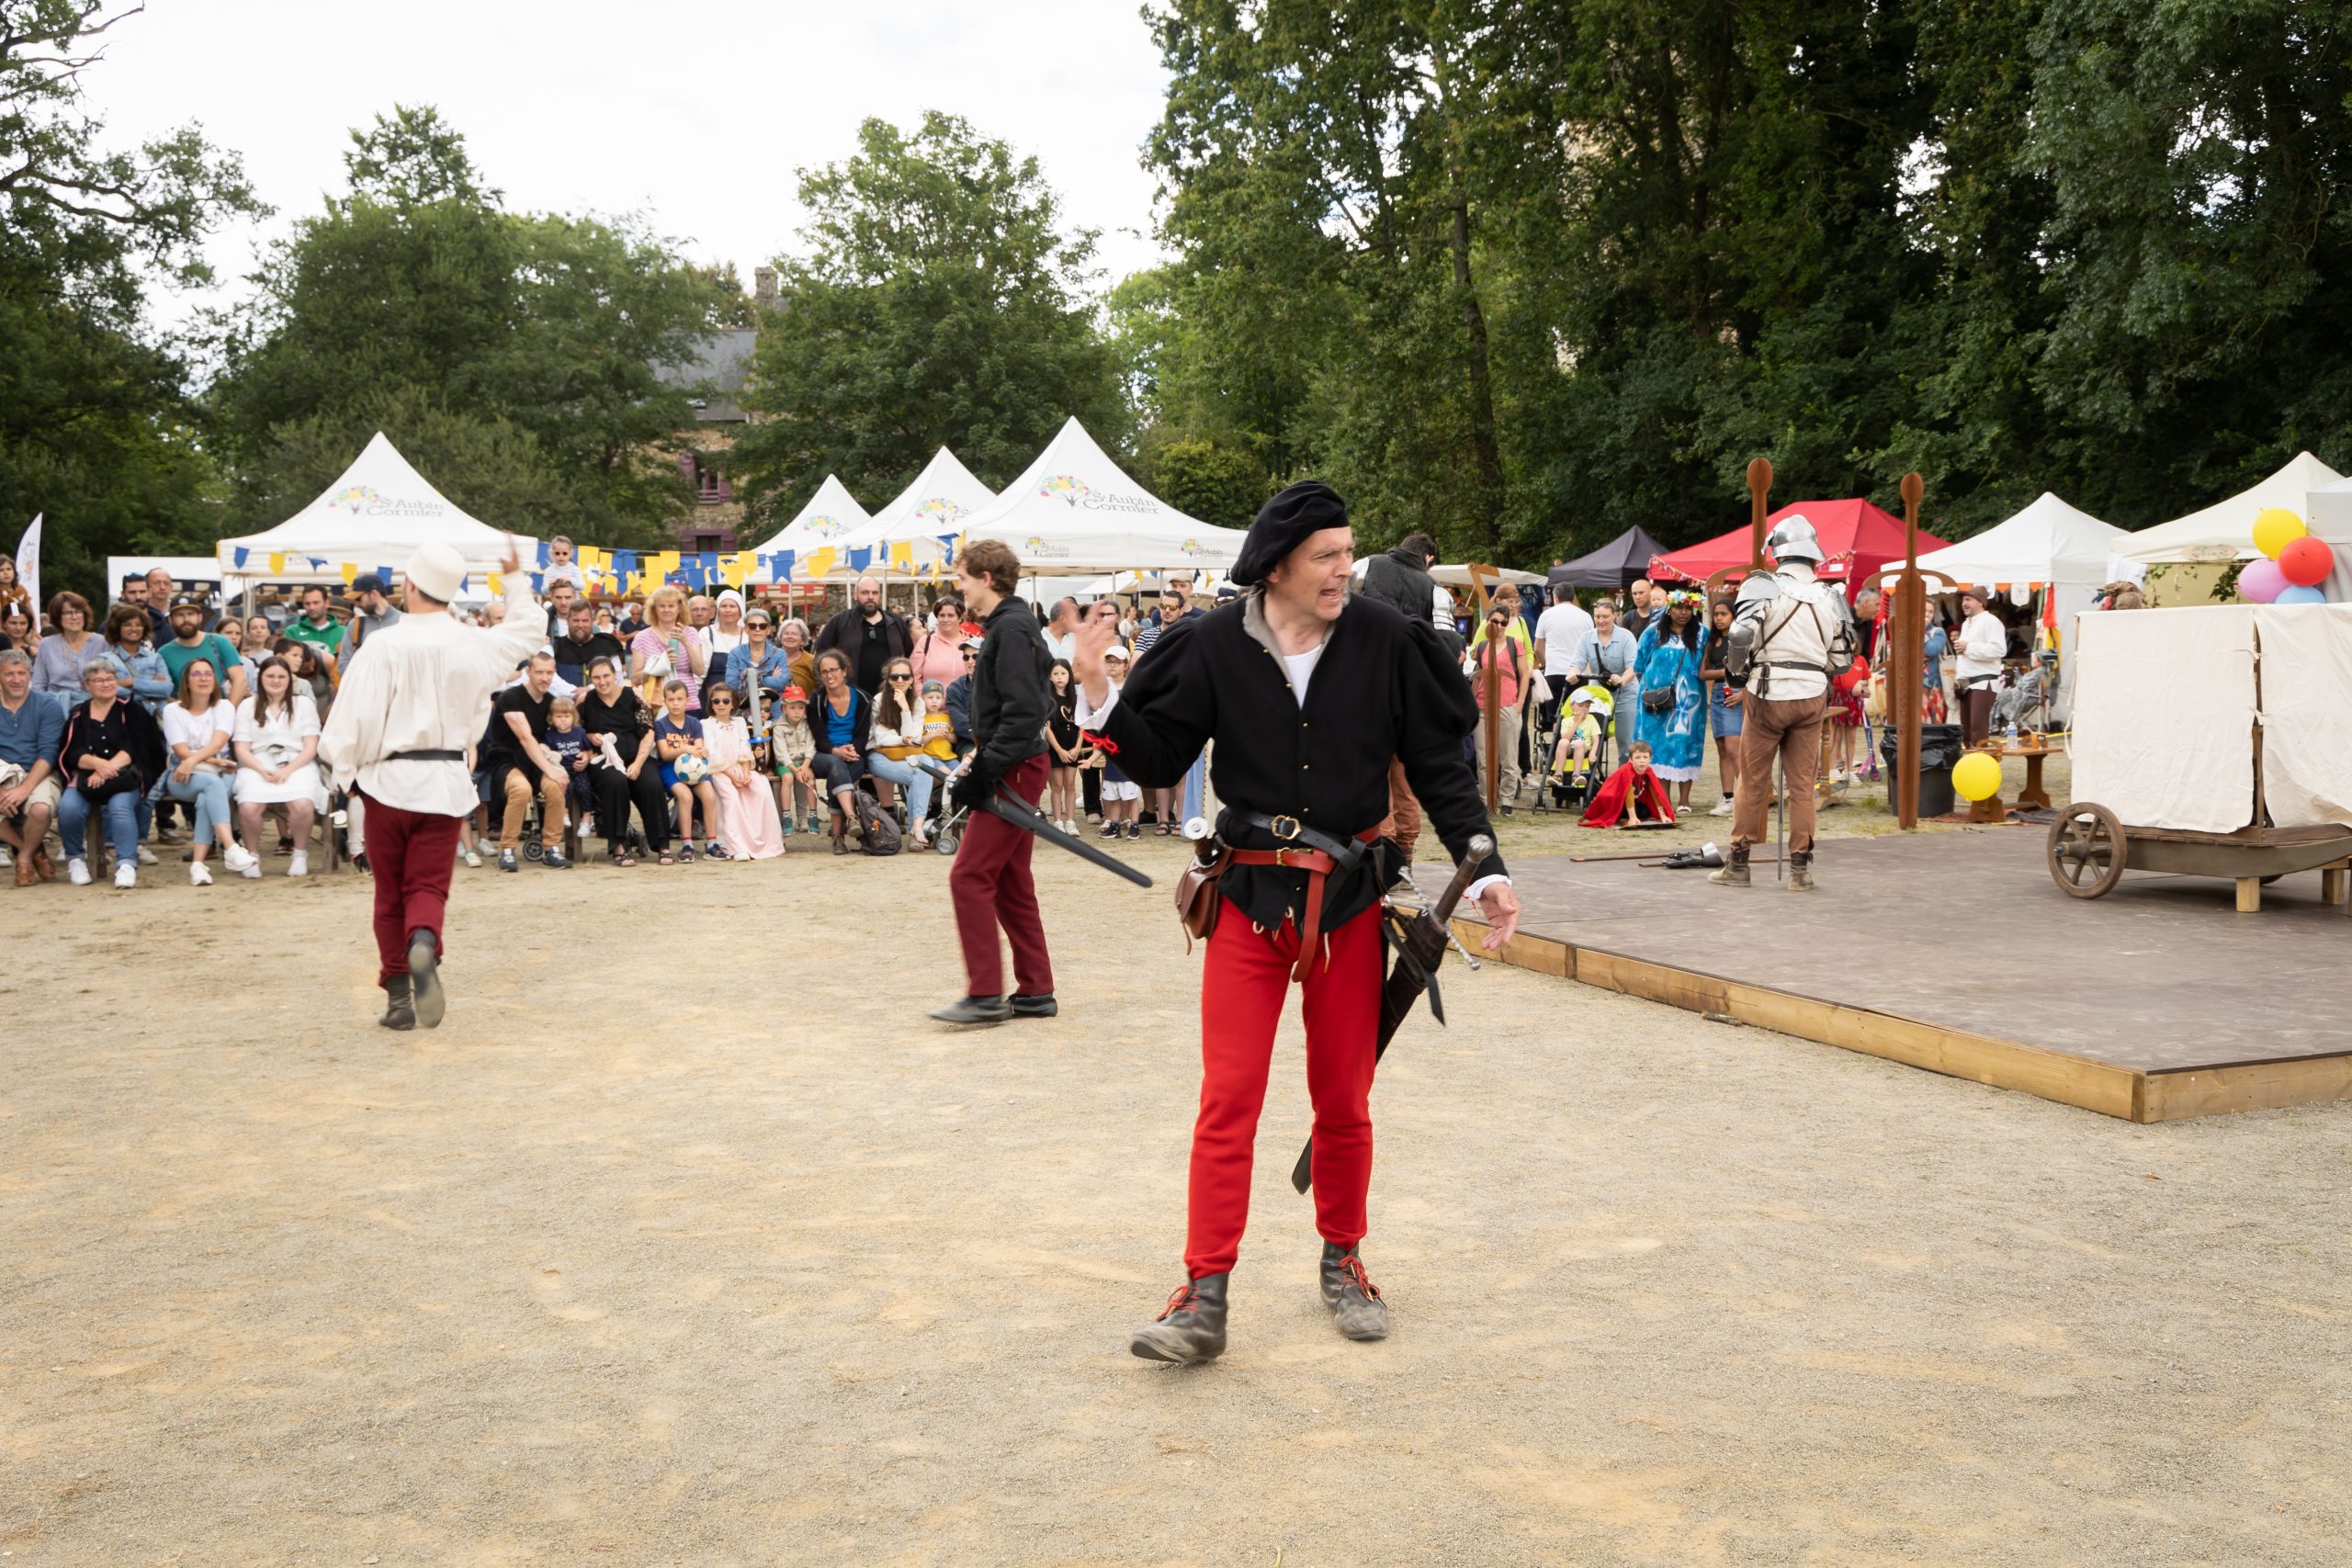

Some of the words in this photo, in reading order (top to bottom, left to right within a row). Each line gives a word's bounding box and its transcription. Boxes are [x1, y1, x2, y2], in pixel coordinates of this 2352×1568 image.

[395, 499, 443, 511] Aubin
[1083, 499, 1159, 514] Cormier
[1109, 493, 1157, 507] Aubin
[367, 505, 443, 517] Cormier
